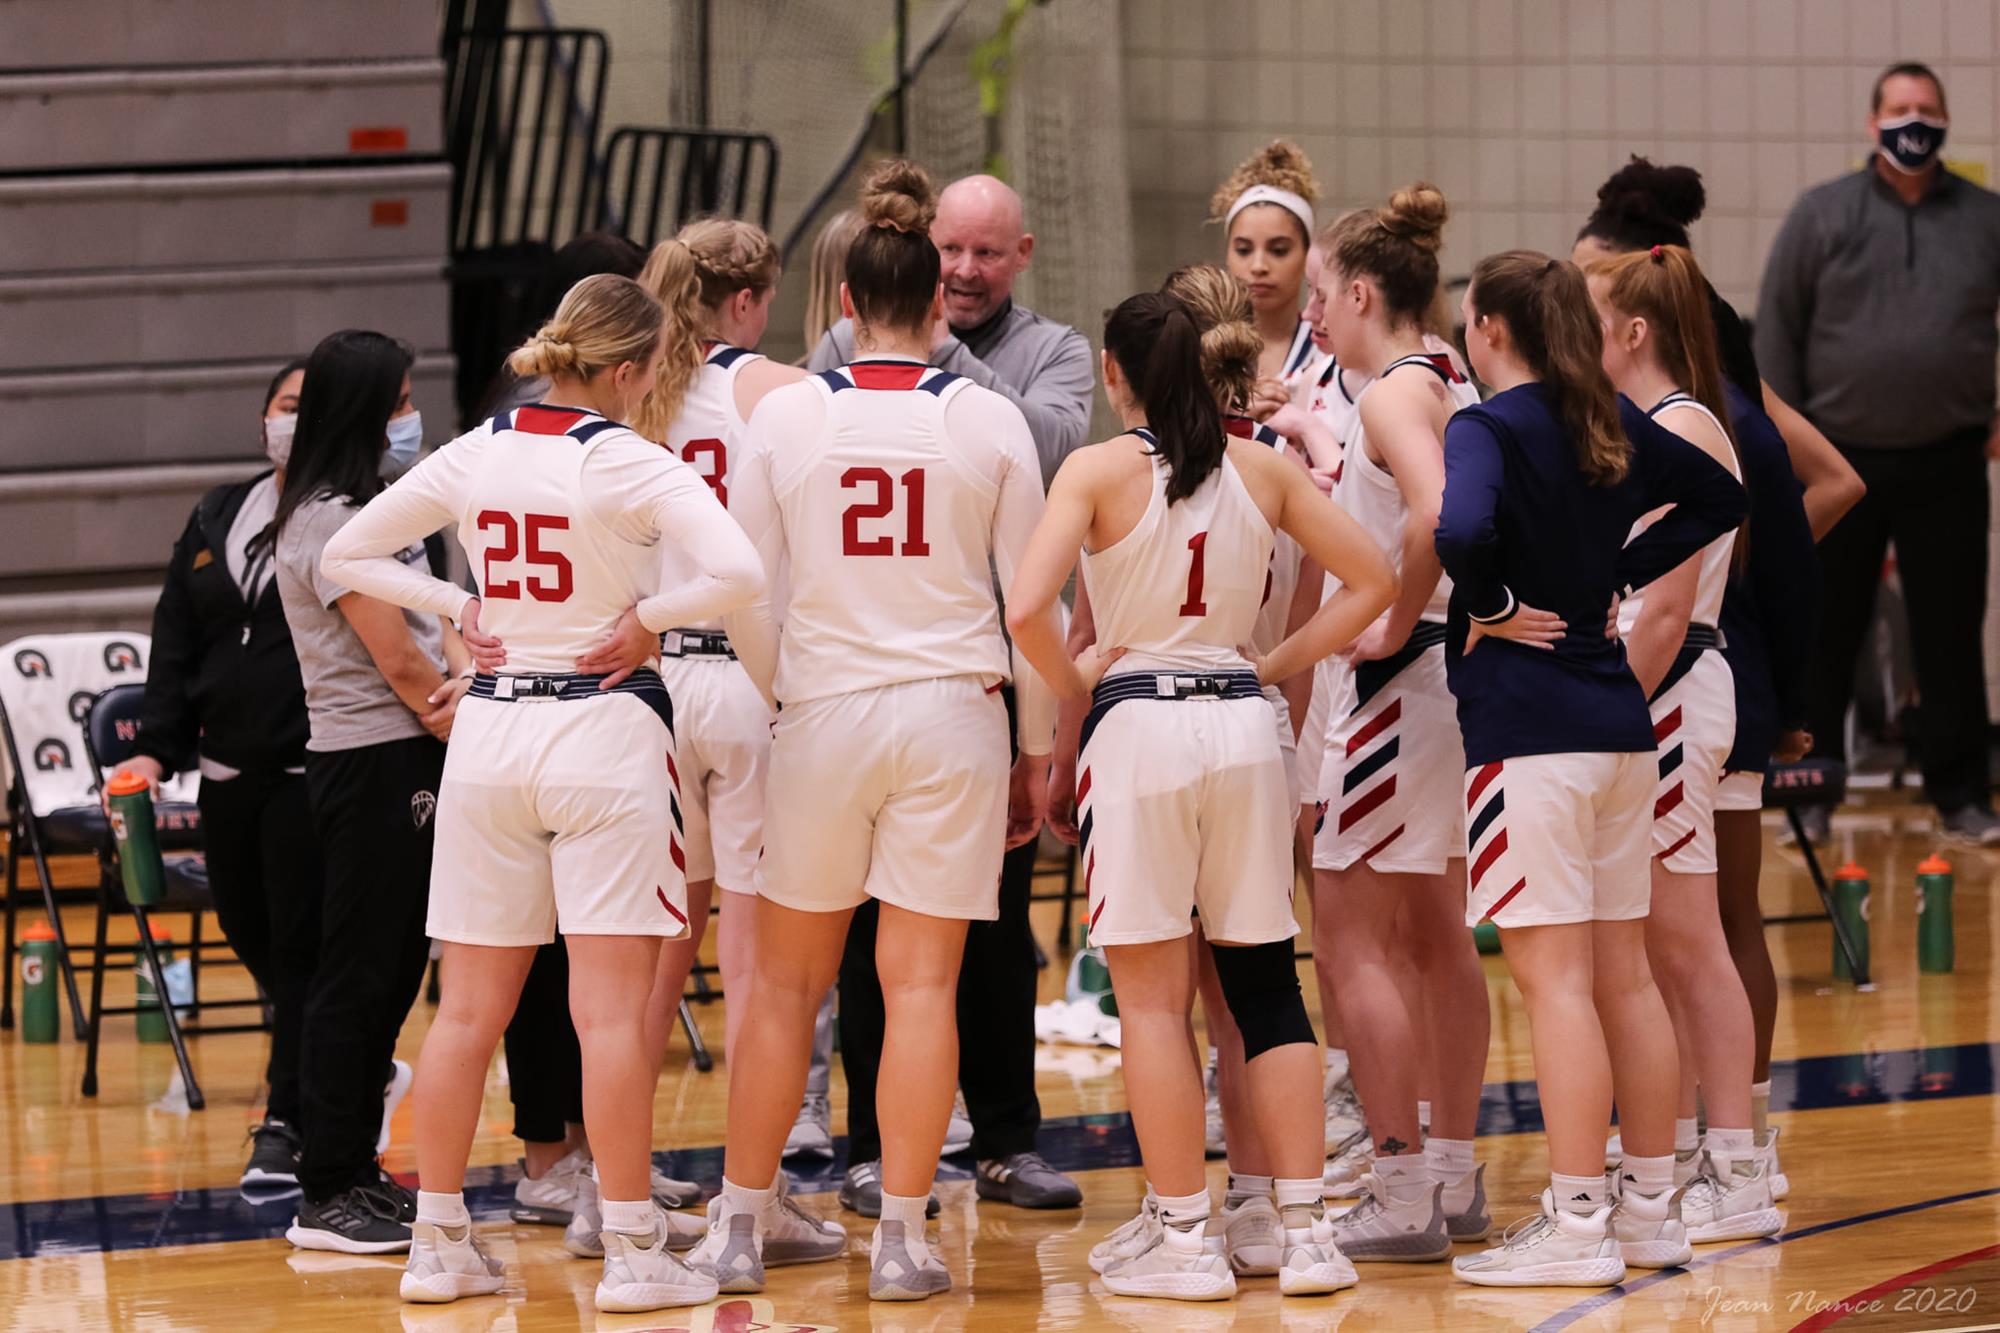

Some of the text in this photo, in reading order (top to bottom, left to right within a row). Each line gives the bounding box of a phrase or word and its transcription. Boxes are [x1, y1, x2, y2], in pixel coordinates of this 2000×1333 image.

[477, 509, 573, 602] 25
[840, 467, 930, 557] 21
[1179, 531, 1208, 617] 1
[156, 809, 200, 830] JET
